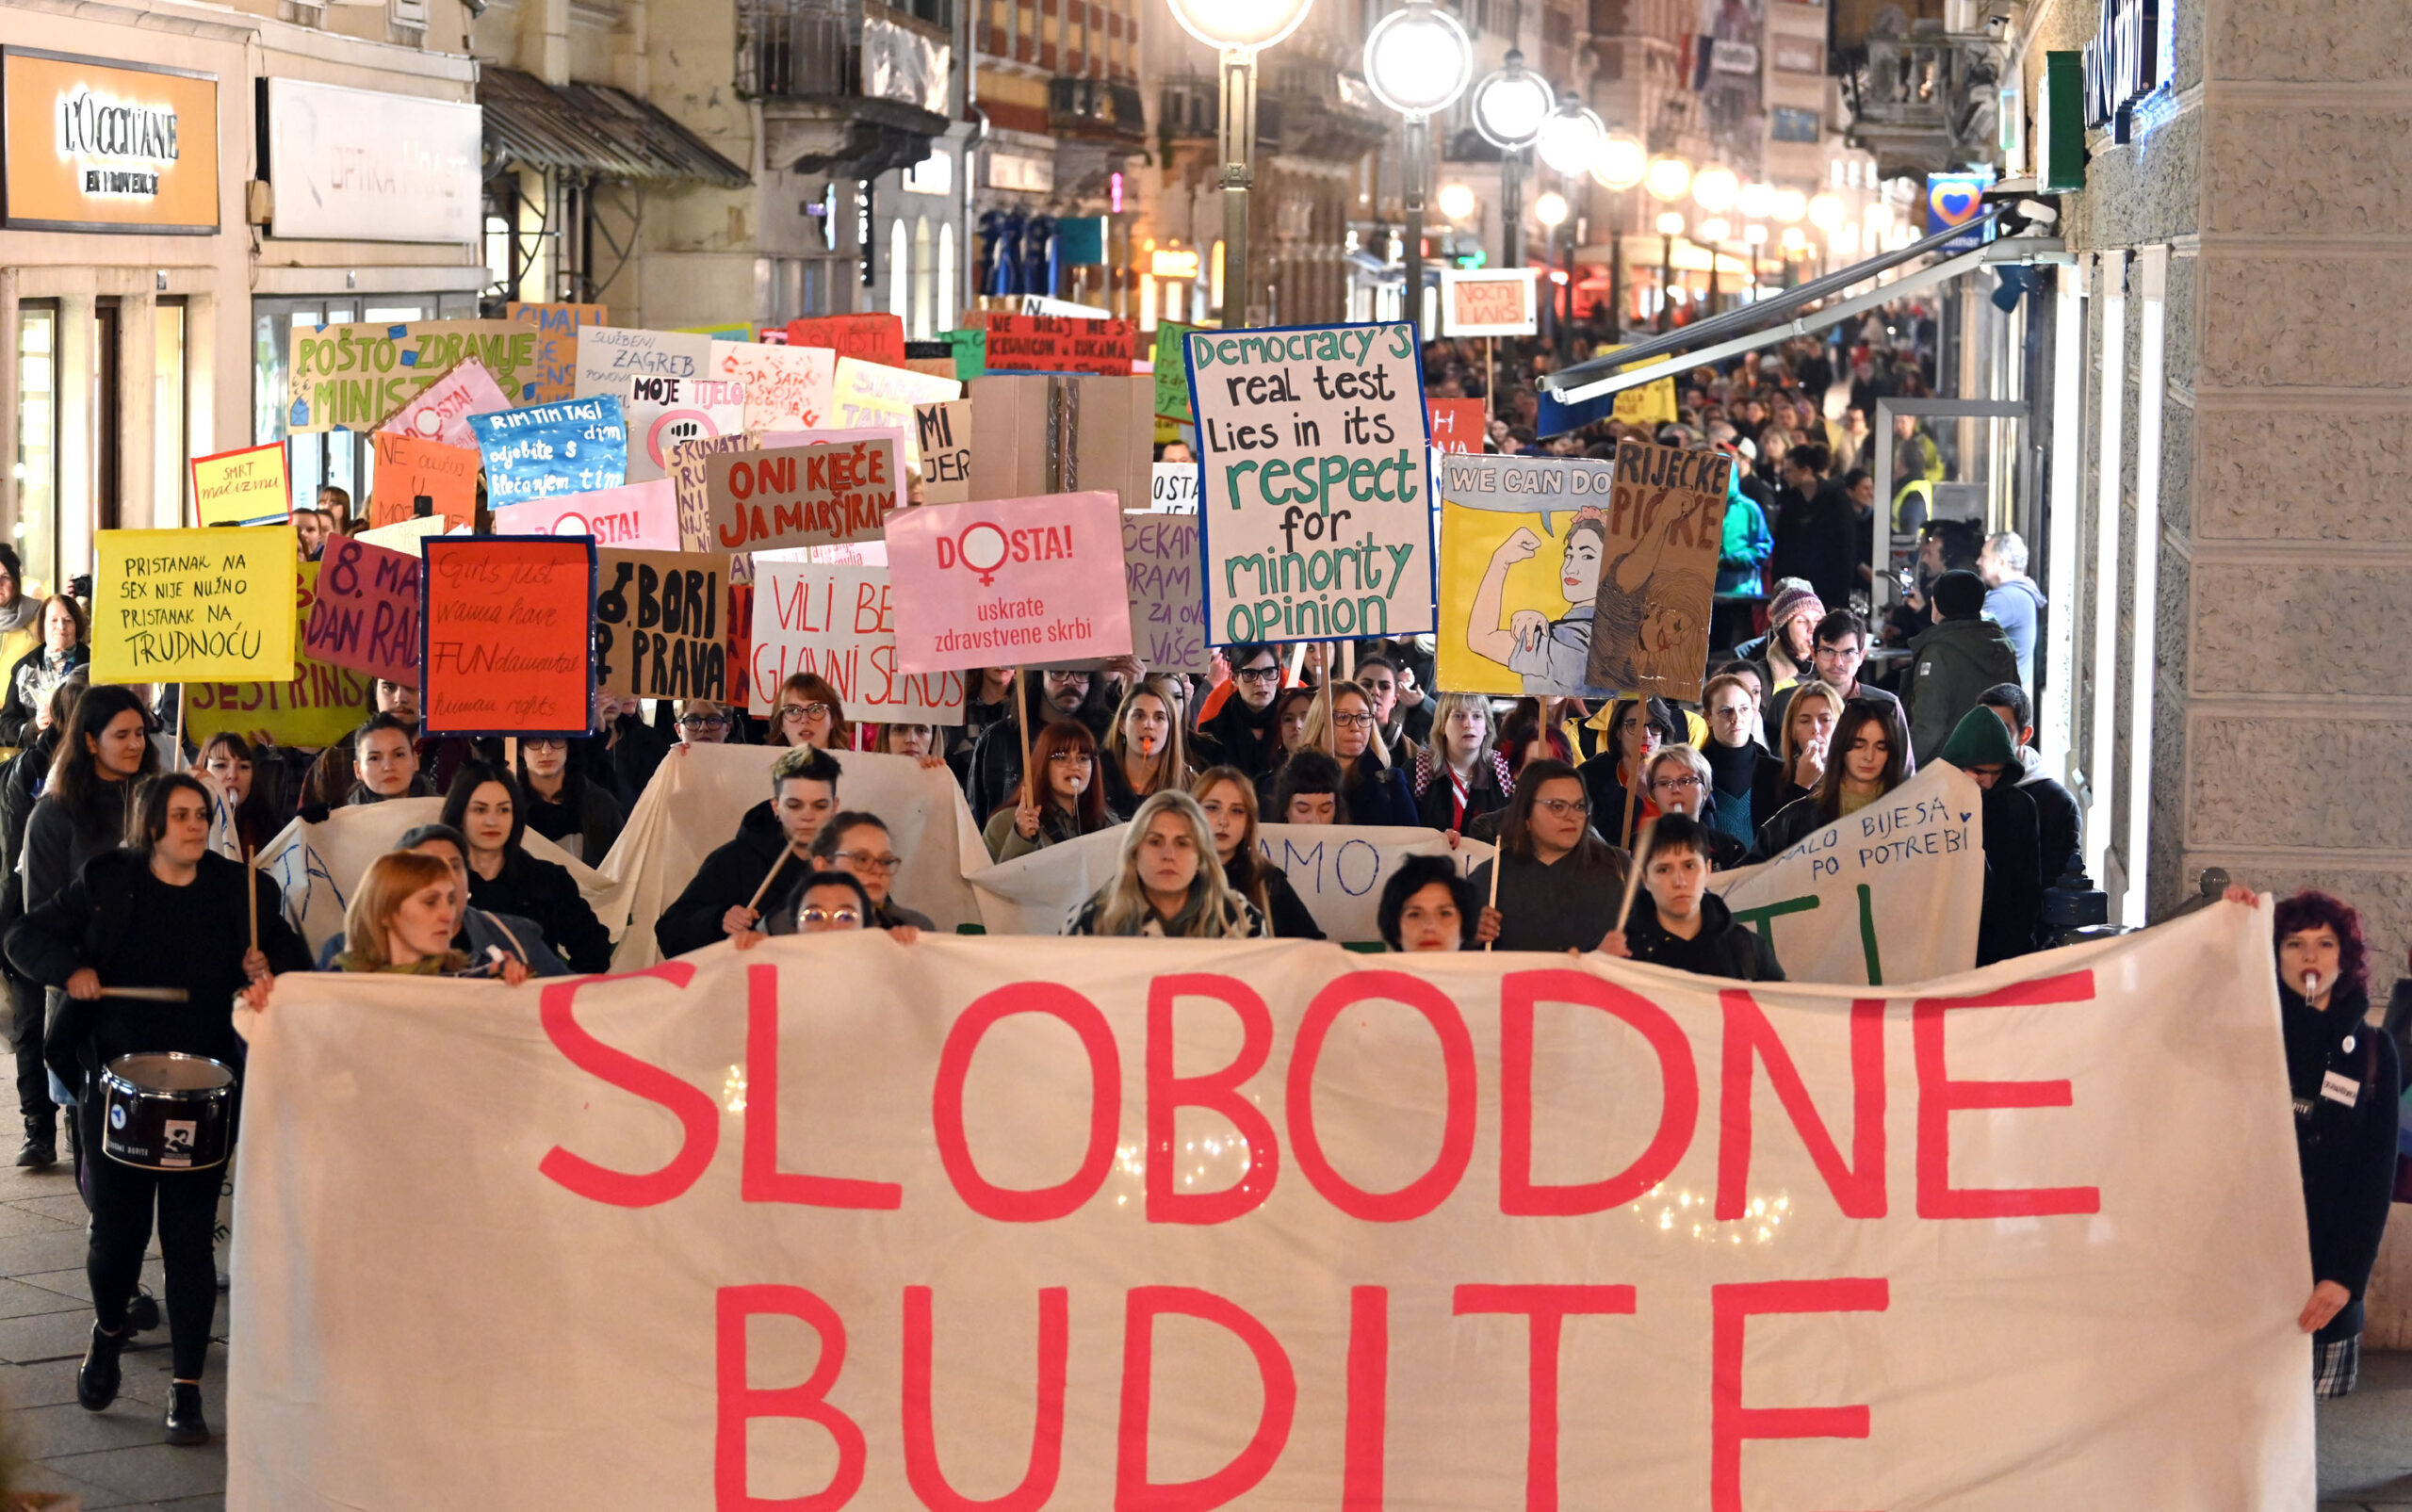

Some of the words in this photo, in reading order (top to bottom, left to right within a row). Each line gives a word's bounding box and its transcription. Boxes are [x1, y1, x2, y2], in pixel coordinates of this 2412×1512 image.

[300, 327, 396, 376] POŠTO
[414, 332, 537, 375] ZDRAVLJE
[612, 350, 694, 377] ZAGREB
[633, 377, 679, 406] MOJE
[692, 381, 743, 410] TIJELO
[1226, 367, 1301, 406] real
[1313, 364, 1395, 400] test
[490, 411, 530, 431] RIM
[530, 407, 563, 425] TIM
[562, 400, 603, 421] TAGI
[583, 424, 622, 442] dim
[1293, 412, 1320, 447] in
[1344, 406, 1394, 445] its
[379, 434, 411, 466] NE
[490, 439, 554, 469] odjebite
[1617, 443, 1729, 496] RIJEČKE
[222, 461, 255, 481] SMRT
[491, 474, 569, 497] klečanjem
[579, 465, 622, 490] tim
[728, 456, 796, 500] ONI
[1225, 448, 1417, 517] respect
[1451, 467, 1495, 493] WE
[1503, 468, 1562, 495] CAN
[1571, 469, 1612, 496] DO
[719, 502, 770, 547] JA
[774, 490, 896, 538] MARŠIRAM
[1279, 505, 1351, 553] for
[124, 554, 211, 577] PRISTANAK
[221, 554, 246, 573] NA
[438, 550, 500, 588] Girls
[489, 556, 564, 595] just
[1225, 531, 1413, 599] minority
[120, 580, 148, 600] SEX
[155, 581, 184, 600] NIJE
[193, 576, 247, 597] NUŽNO
[121, 608, 194, 629] PRISTANAK
[207, 604, 232, 623] NA
[306, 596, 364, 655] DAN
[509, 595, 559, 627] have
[977, 597, 1044, 622] uskrate
[1149, 603, 1171, 626] ZA
[1227, 593, 1388, 643] opinion
[124, 621, 261, 667] TRUDNOĆU
[935, 627, 1042, 653] zdravstvene
[1047, 617, 1092, 642] skrbi
[1149, 626, 1200, 667] VIŠE
[631, 628, 725, 701] PRAVA
[433, 691, 498, 716] human
[504, 693, 558, 724] rights
[1861, 796, 1949, 838] BIJESA
[1812, 855, 1840, 882] PO
[1858, 826, 1968, 869] POTREBI
[537, 962, 2103, 1225] SLOBODNE
